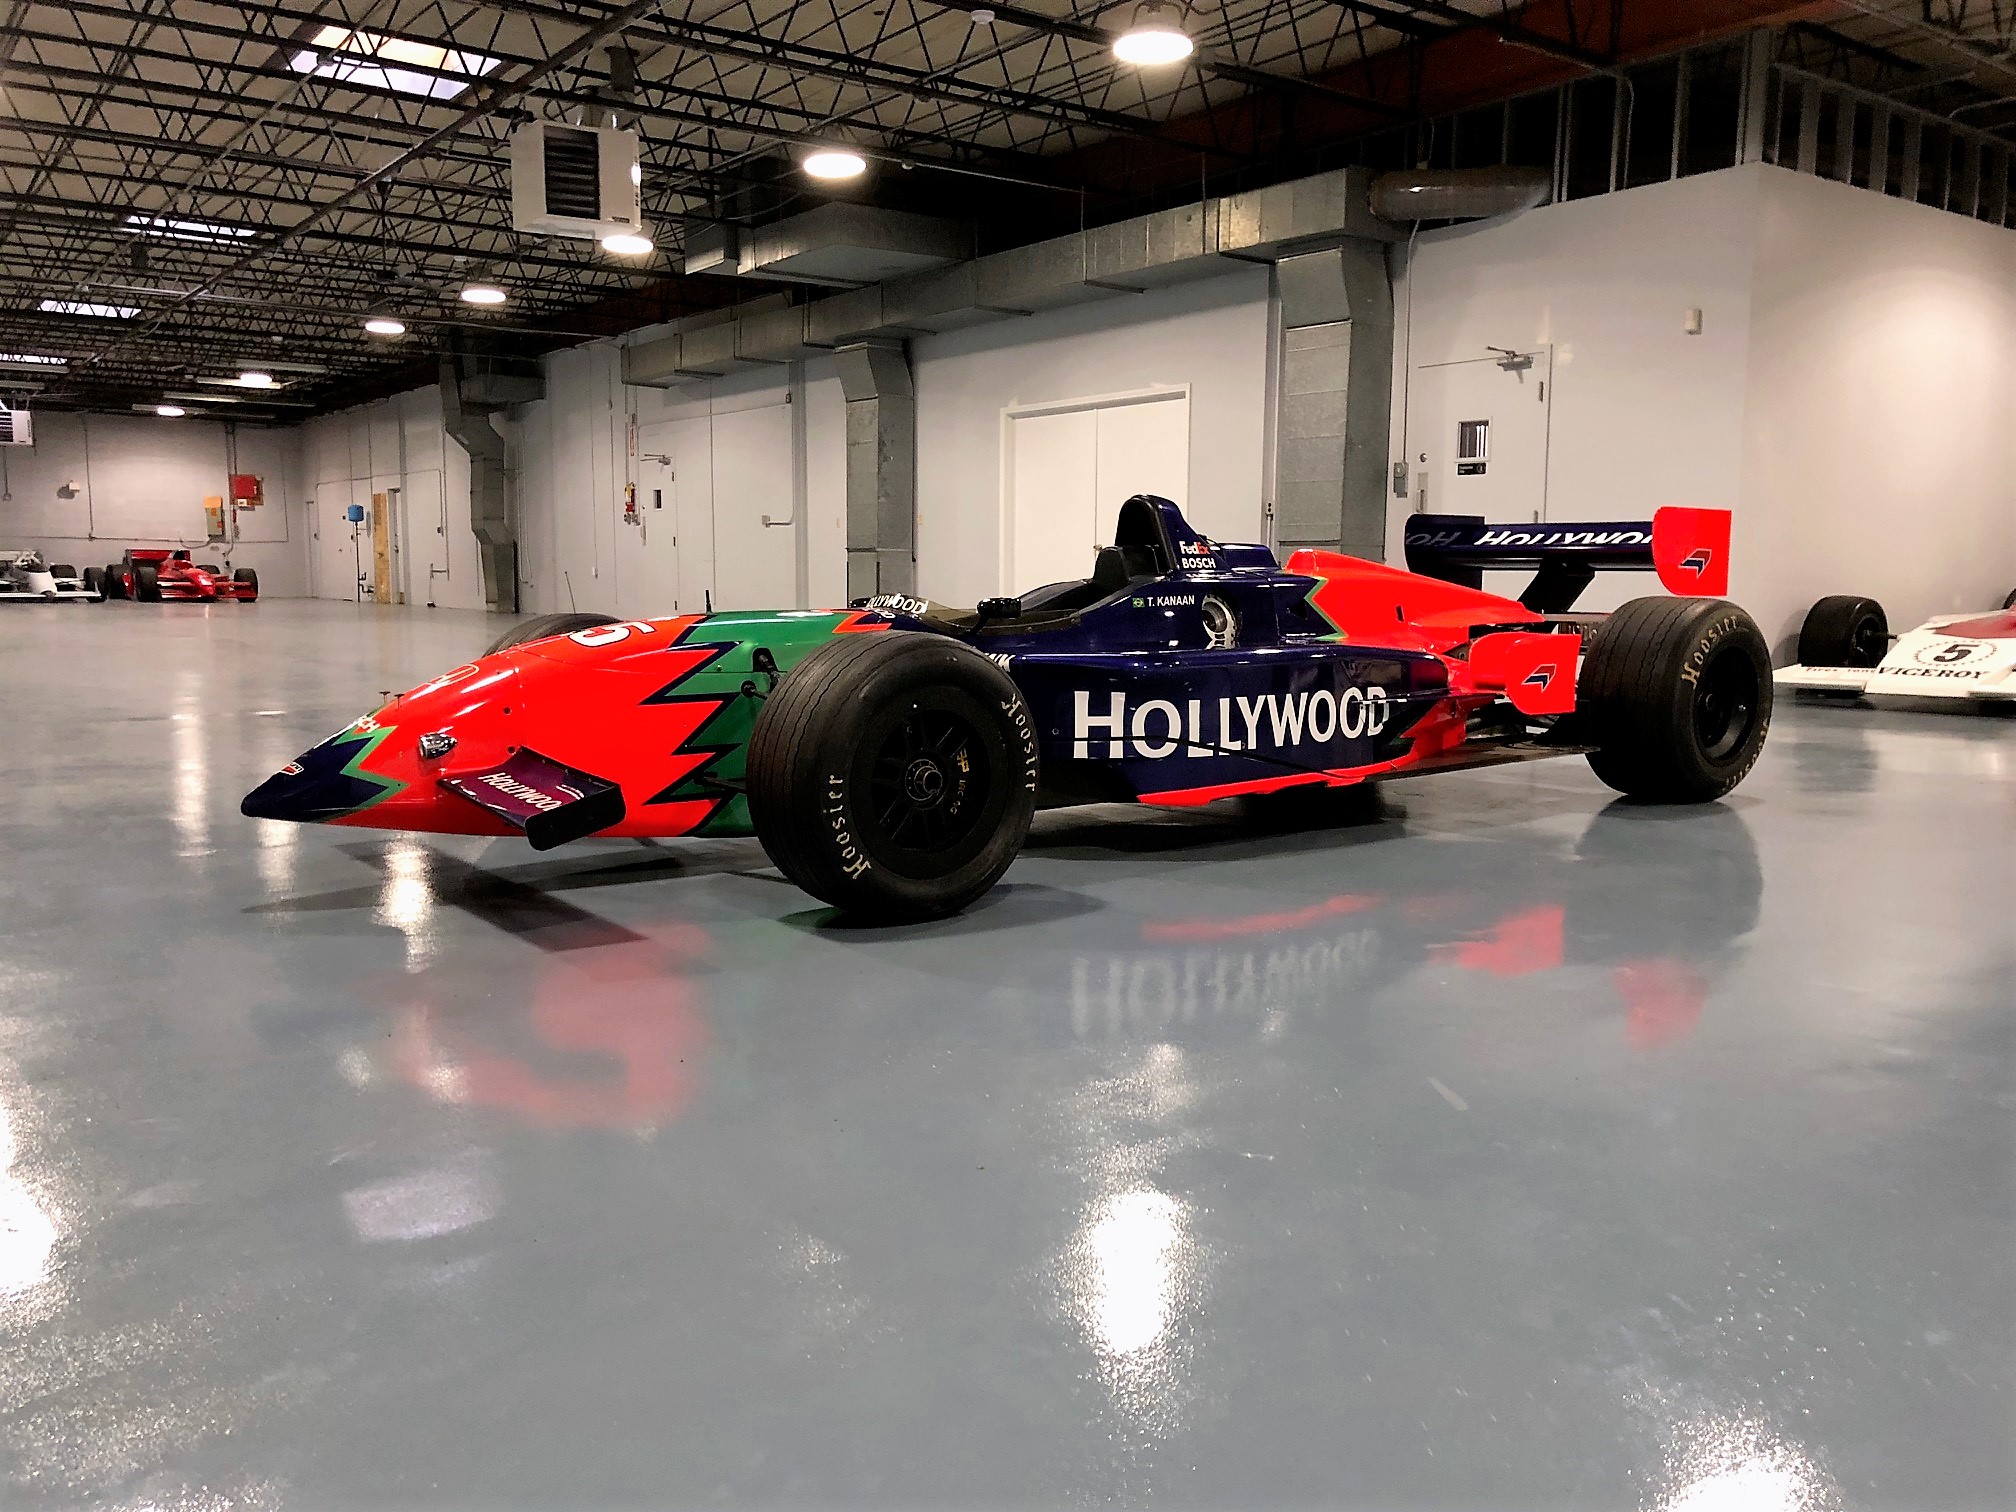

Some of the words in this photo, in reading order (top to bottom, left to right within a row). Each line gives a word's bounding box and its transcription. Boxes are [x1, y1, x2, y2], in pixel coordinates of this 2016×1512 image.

[1179, 541, 1210, 554] FedEx
[1182, 558, 1216, 569] BOSCH
[1147, 597, 1155, 607] T.
[1157, 595, 1195, 606] KANAAN
[1933, 644, 1979, 662] 5
[1878, 667, 1990, 679] VICEROY
[1073, 686, 1389, 759] HOLLYWOOD
[822, 775, 872, 879] Hoosier
